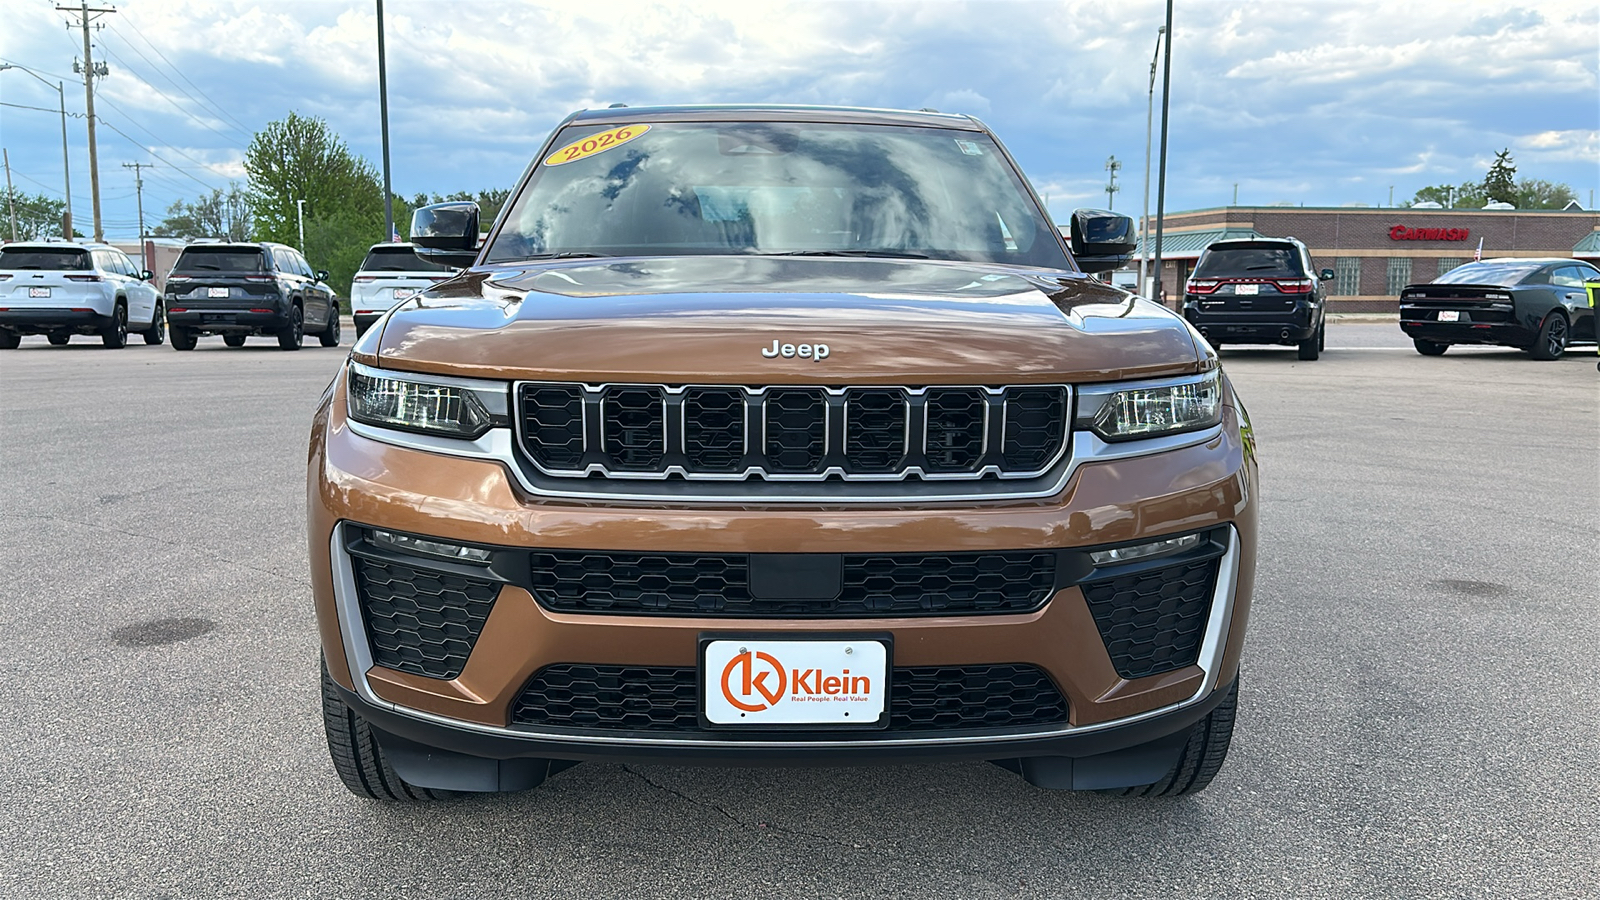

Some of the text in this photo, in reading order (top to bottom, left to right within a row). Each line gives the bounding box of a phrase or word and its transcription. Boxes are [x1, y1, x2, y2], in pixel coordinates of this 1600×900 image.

[564, 127, 632, 161] 2026
[1389, 224, 1469, 241] CARWASH
[761, 339, 830, 362] Jeep
[791, 669, 871, 695] Klein
